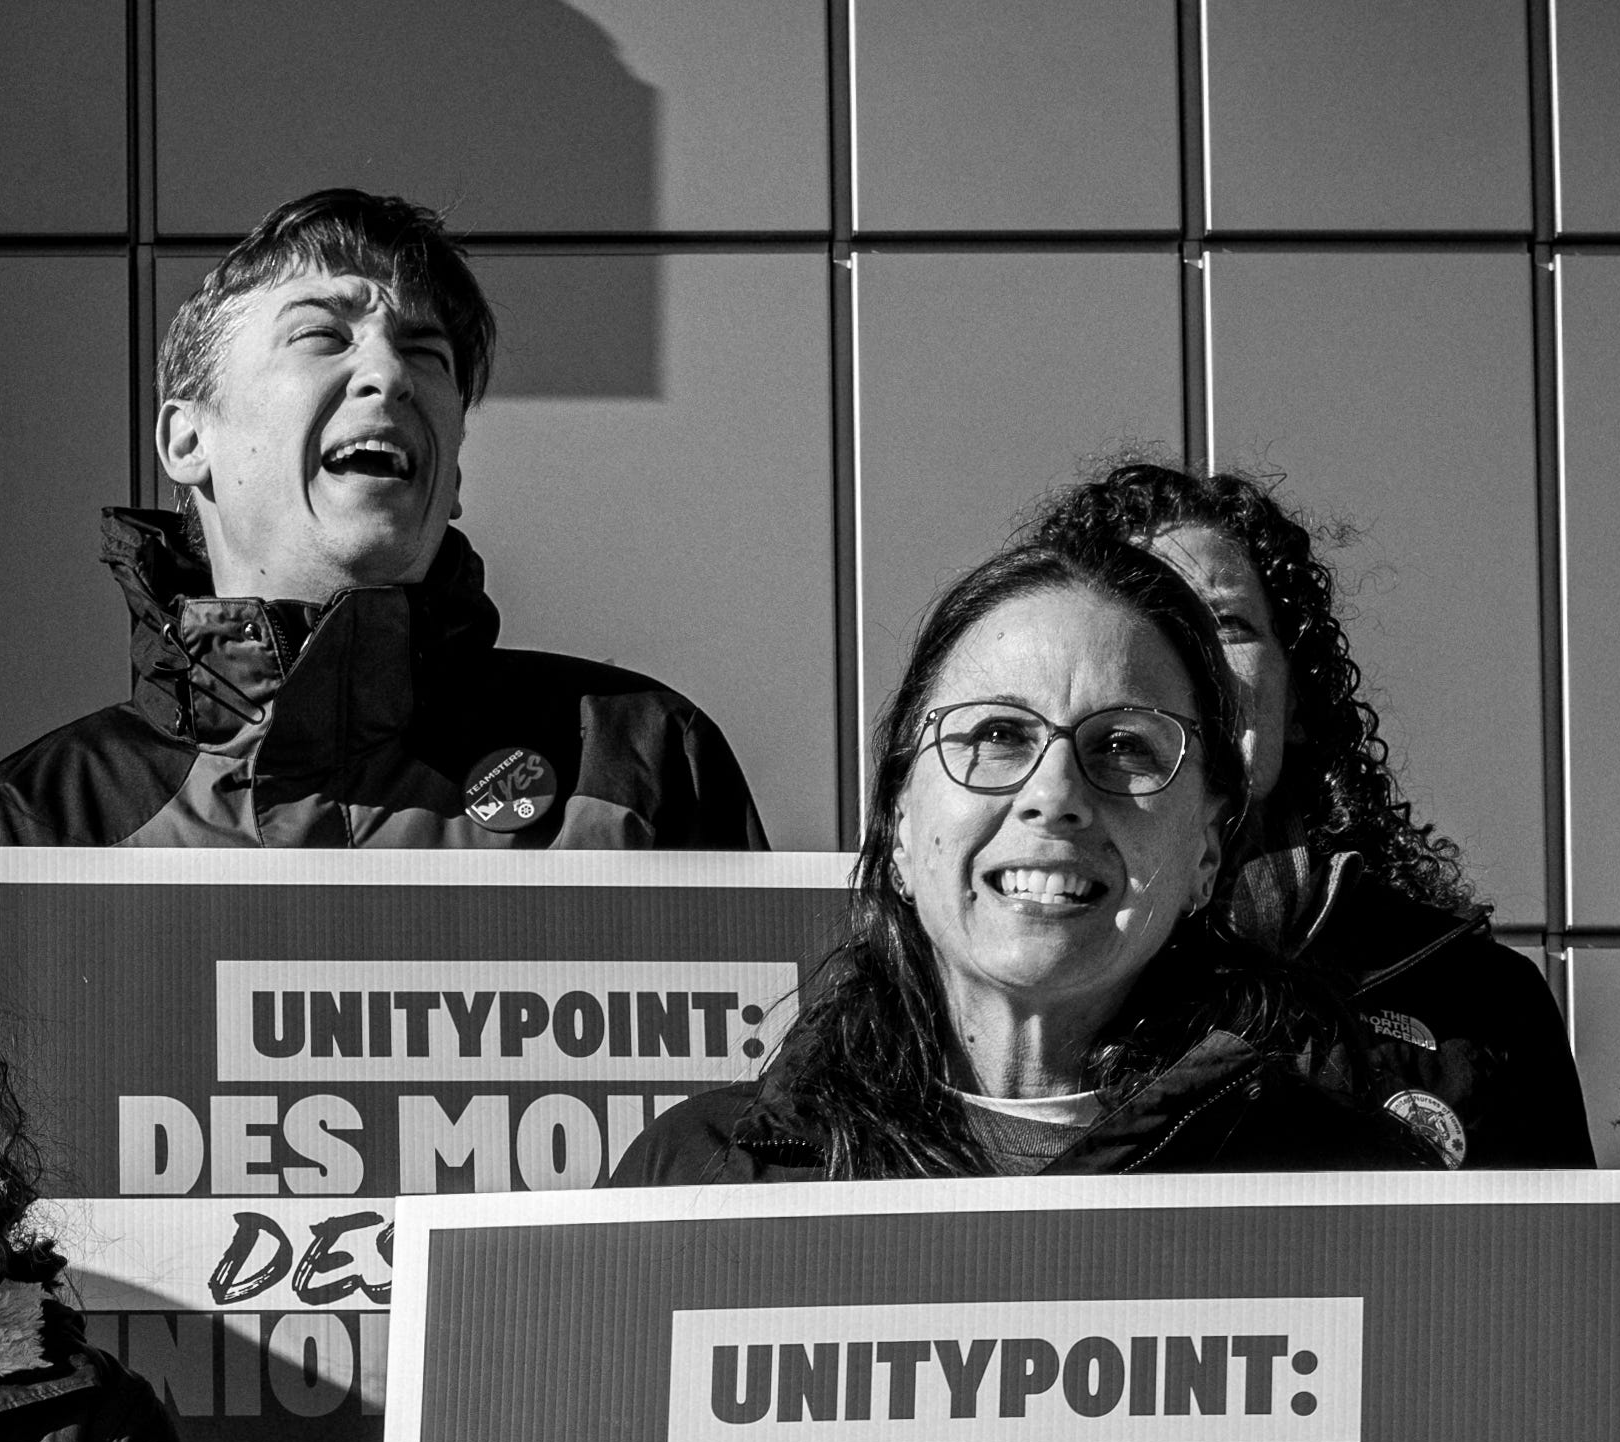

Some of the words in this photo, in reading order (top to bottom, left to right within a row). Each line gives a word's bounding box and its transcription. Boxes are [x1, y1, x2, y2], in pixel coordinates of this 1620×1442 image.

[466, 749, 524, 796] TEAMSTERS
[497, 754, 544, 801] YES
[250, 988, 767, 1060] UNITYPOINT:
[118, 1094, 364, 1196] DES
[398, 1094, 690, 1196] MOI
[85, 1313, 390, 1418] NIO
[709, 1333, 1319, 1425] UNITYPOINT:
